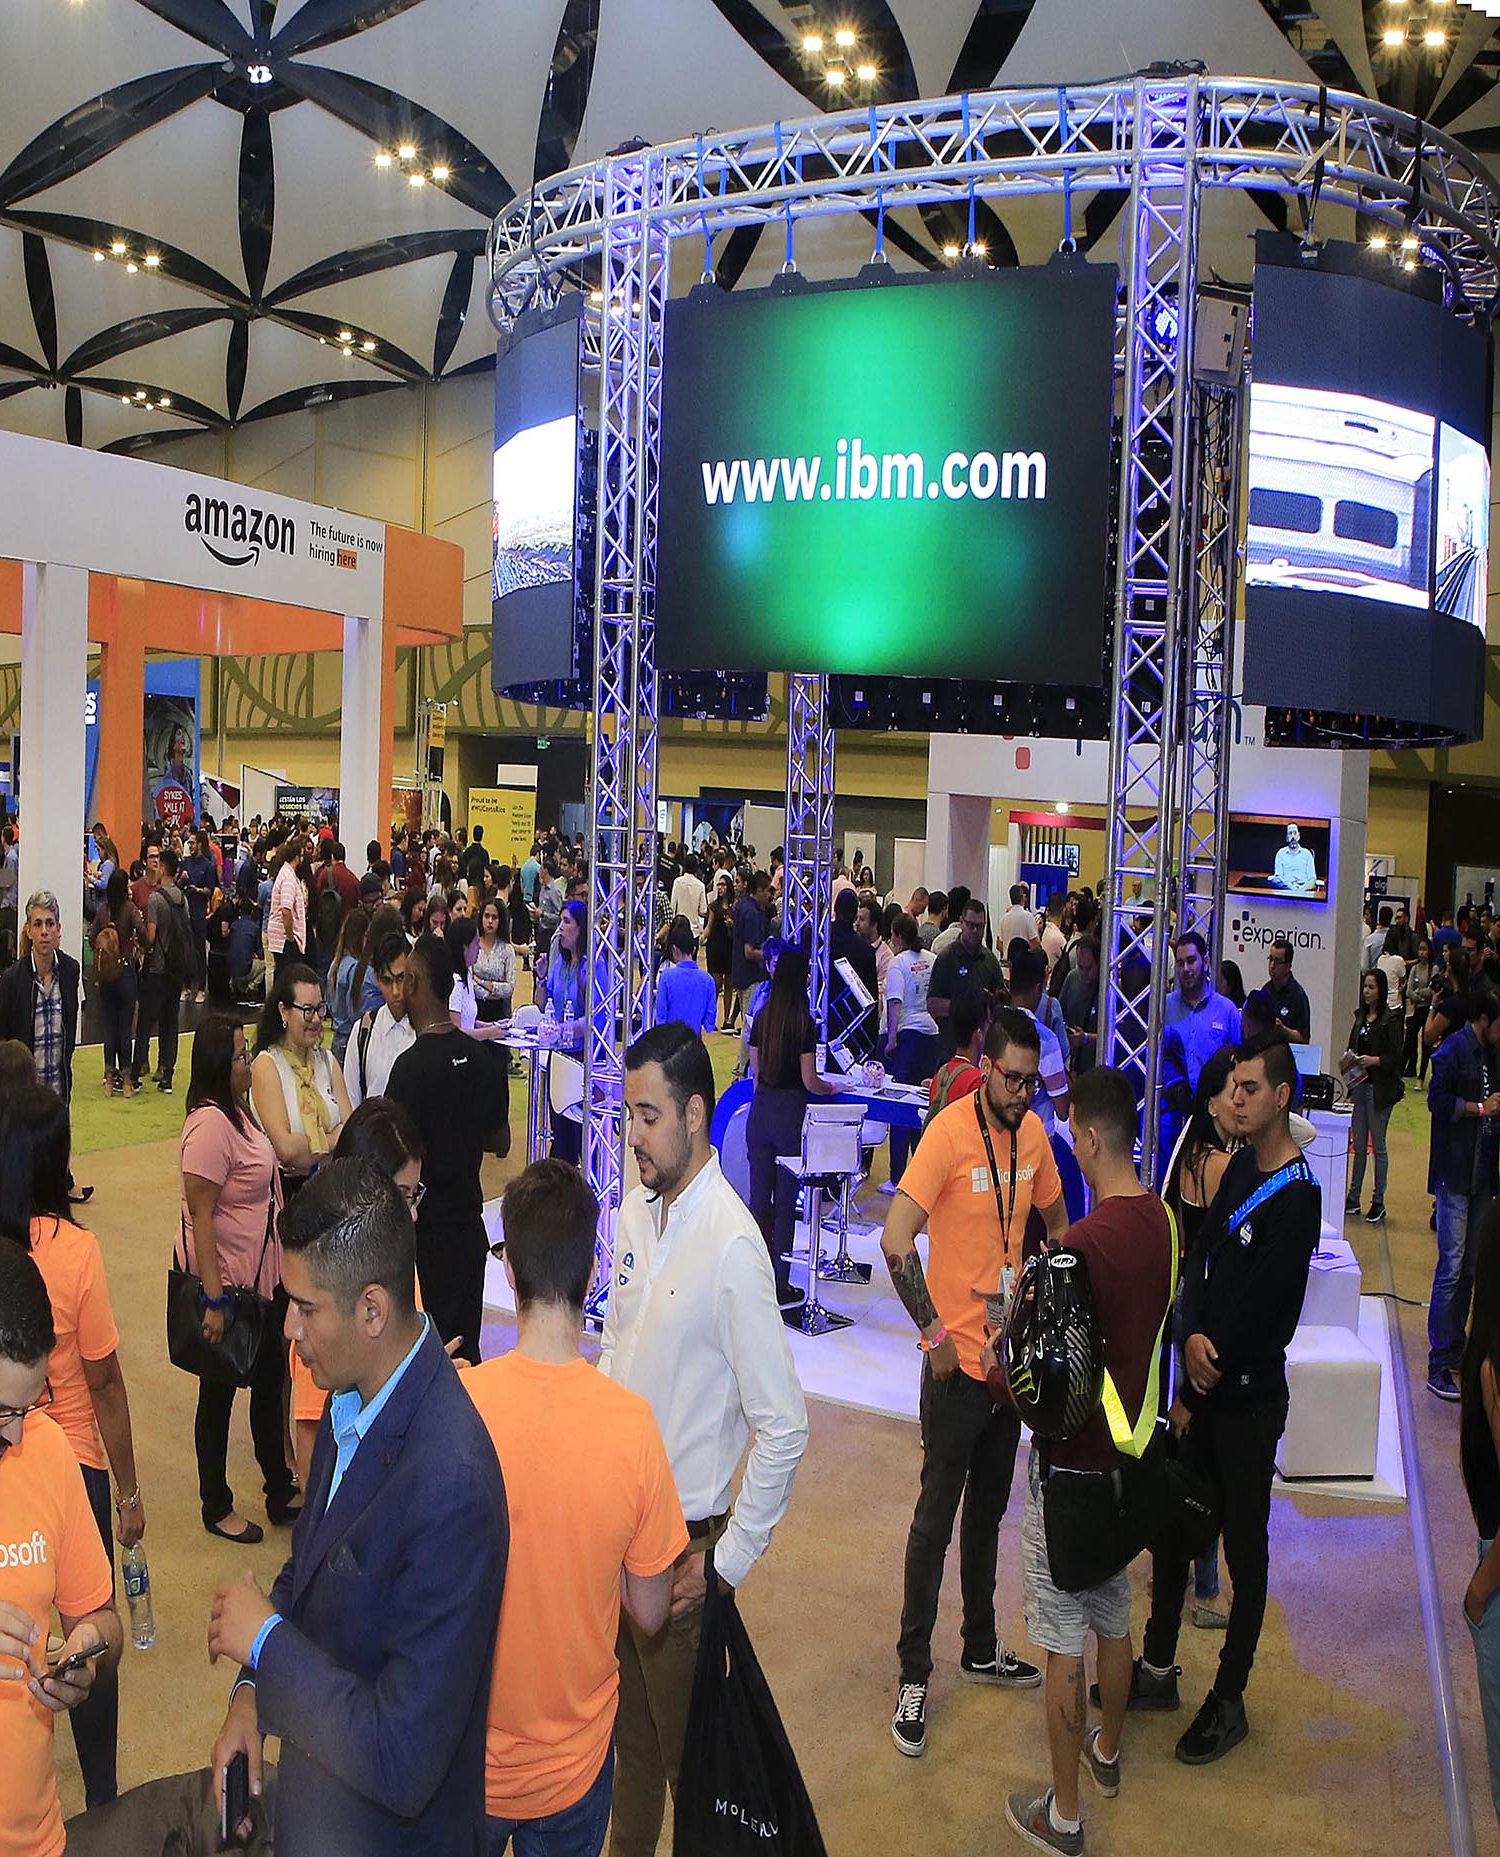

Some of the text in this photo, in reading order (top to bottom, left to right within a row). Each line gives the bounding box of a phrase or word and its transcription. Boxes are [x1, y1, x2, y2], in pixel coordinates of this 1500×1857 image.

[701, 437, 1047, 505] www.ibm.com
[184, 493, 295, 555] amazon
[309, 521, 383, 553] The future is now
[309, 543, 357, 568] hiring here
[164, 791, 183, 801] SYKES
[1242, 926, 1321, 950] experian
